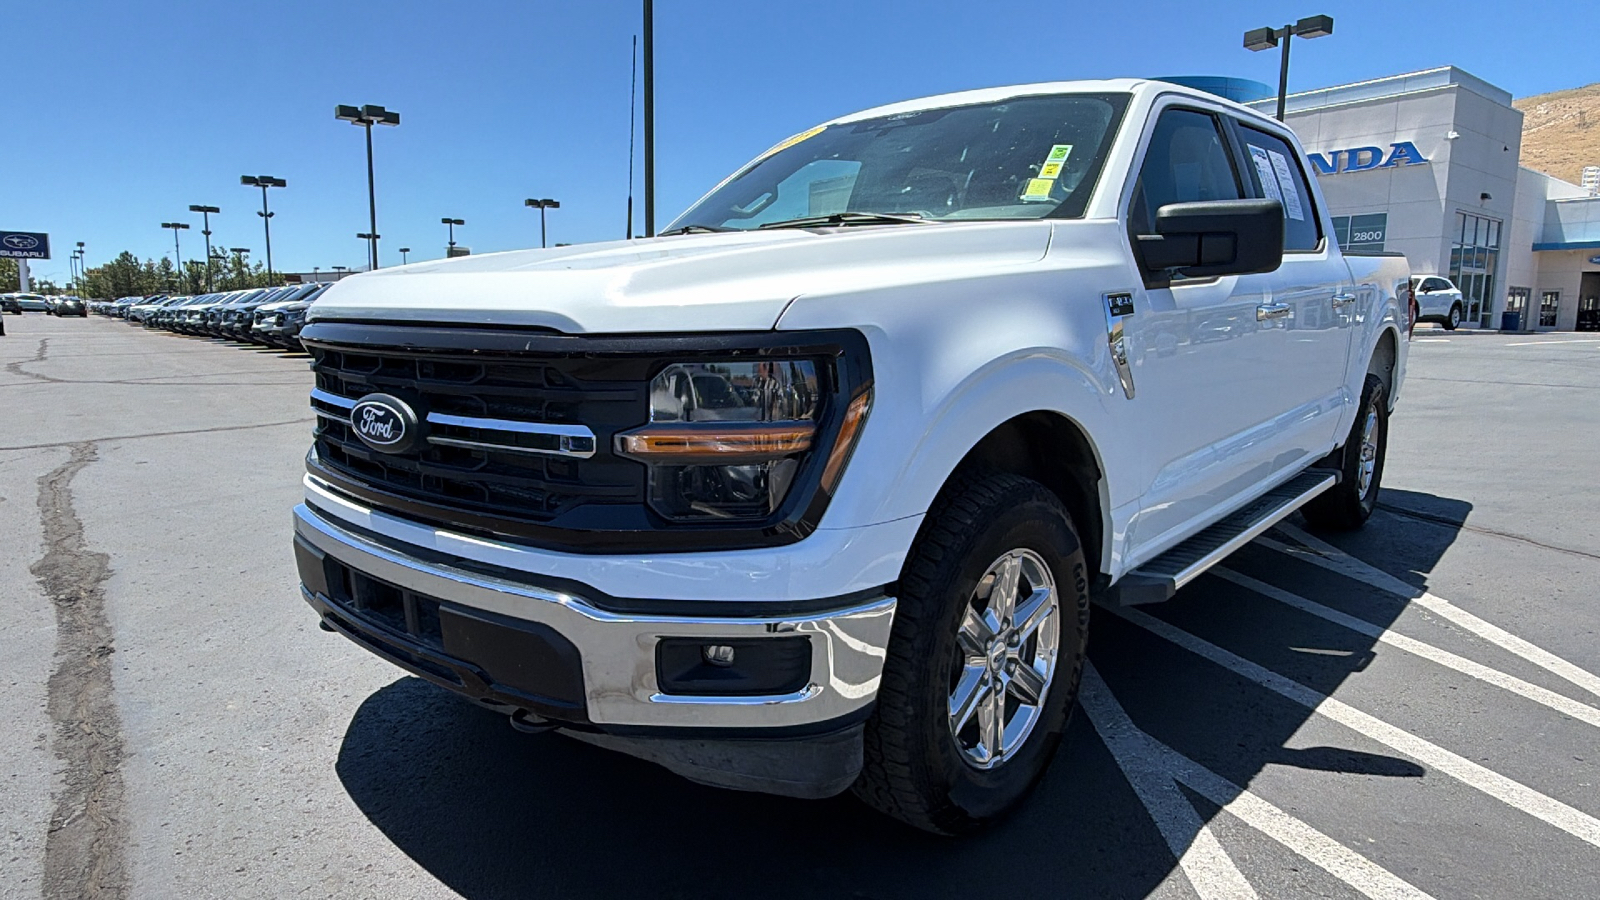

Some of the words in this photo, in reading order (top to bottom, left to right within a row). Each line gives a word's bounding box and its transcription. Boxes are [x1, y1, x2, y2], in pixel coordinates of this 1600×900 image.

[1307, 141, 1430, 175] NDA
[1353, 231, 1382, 242] 2800
[360, 406, 395, 439] Ford
